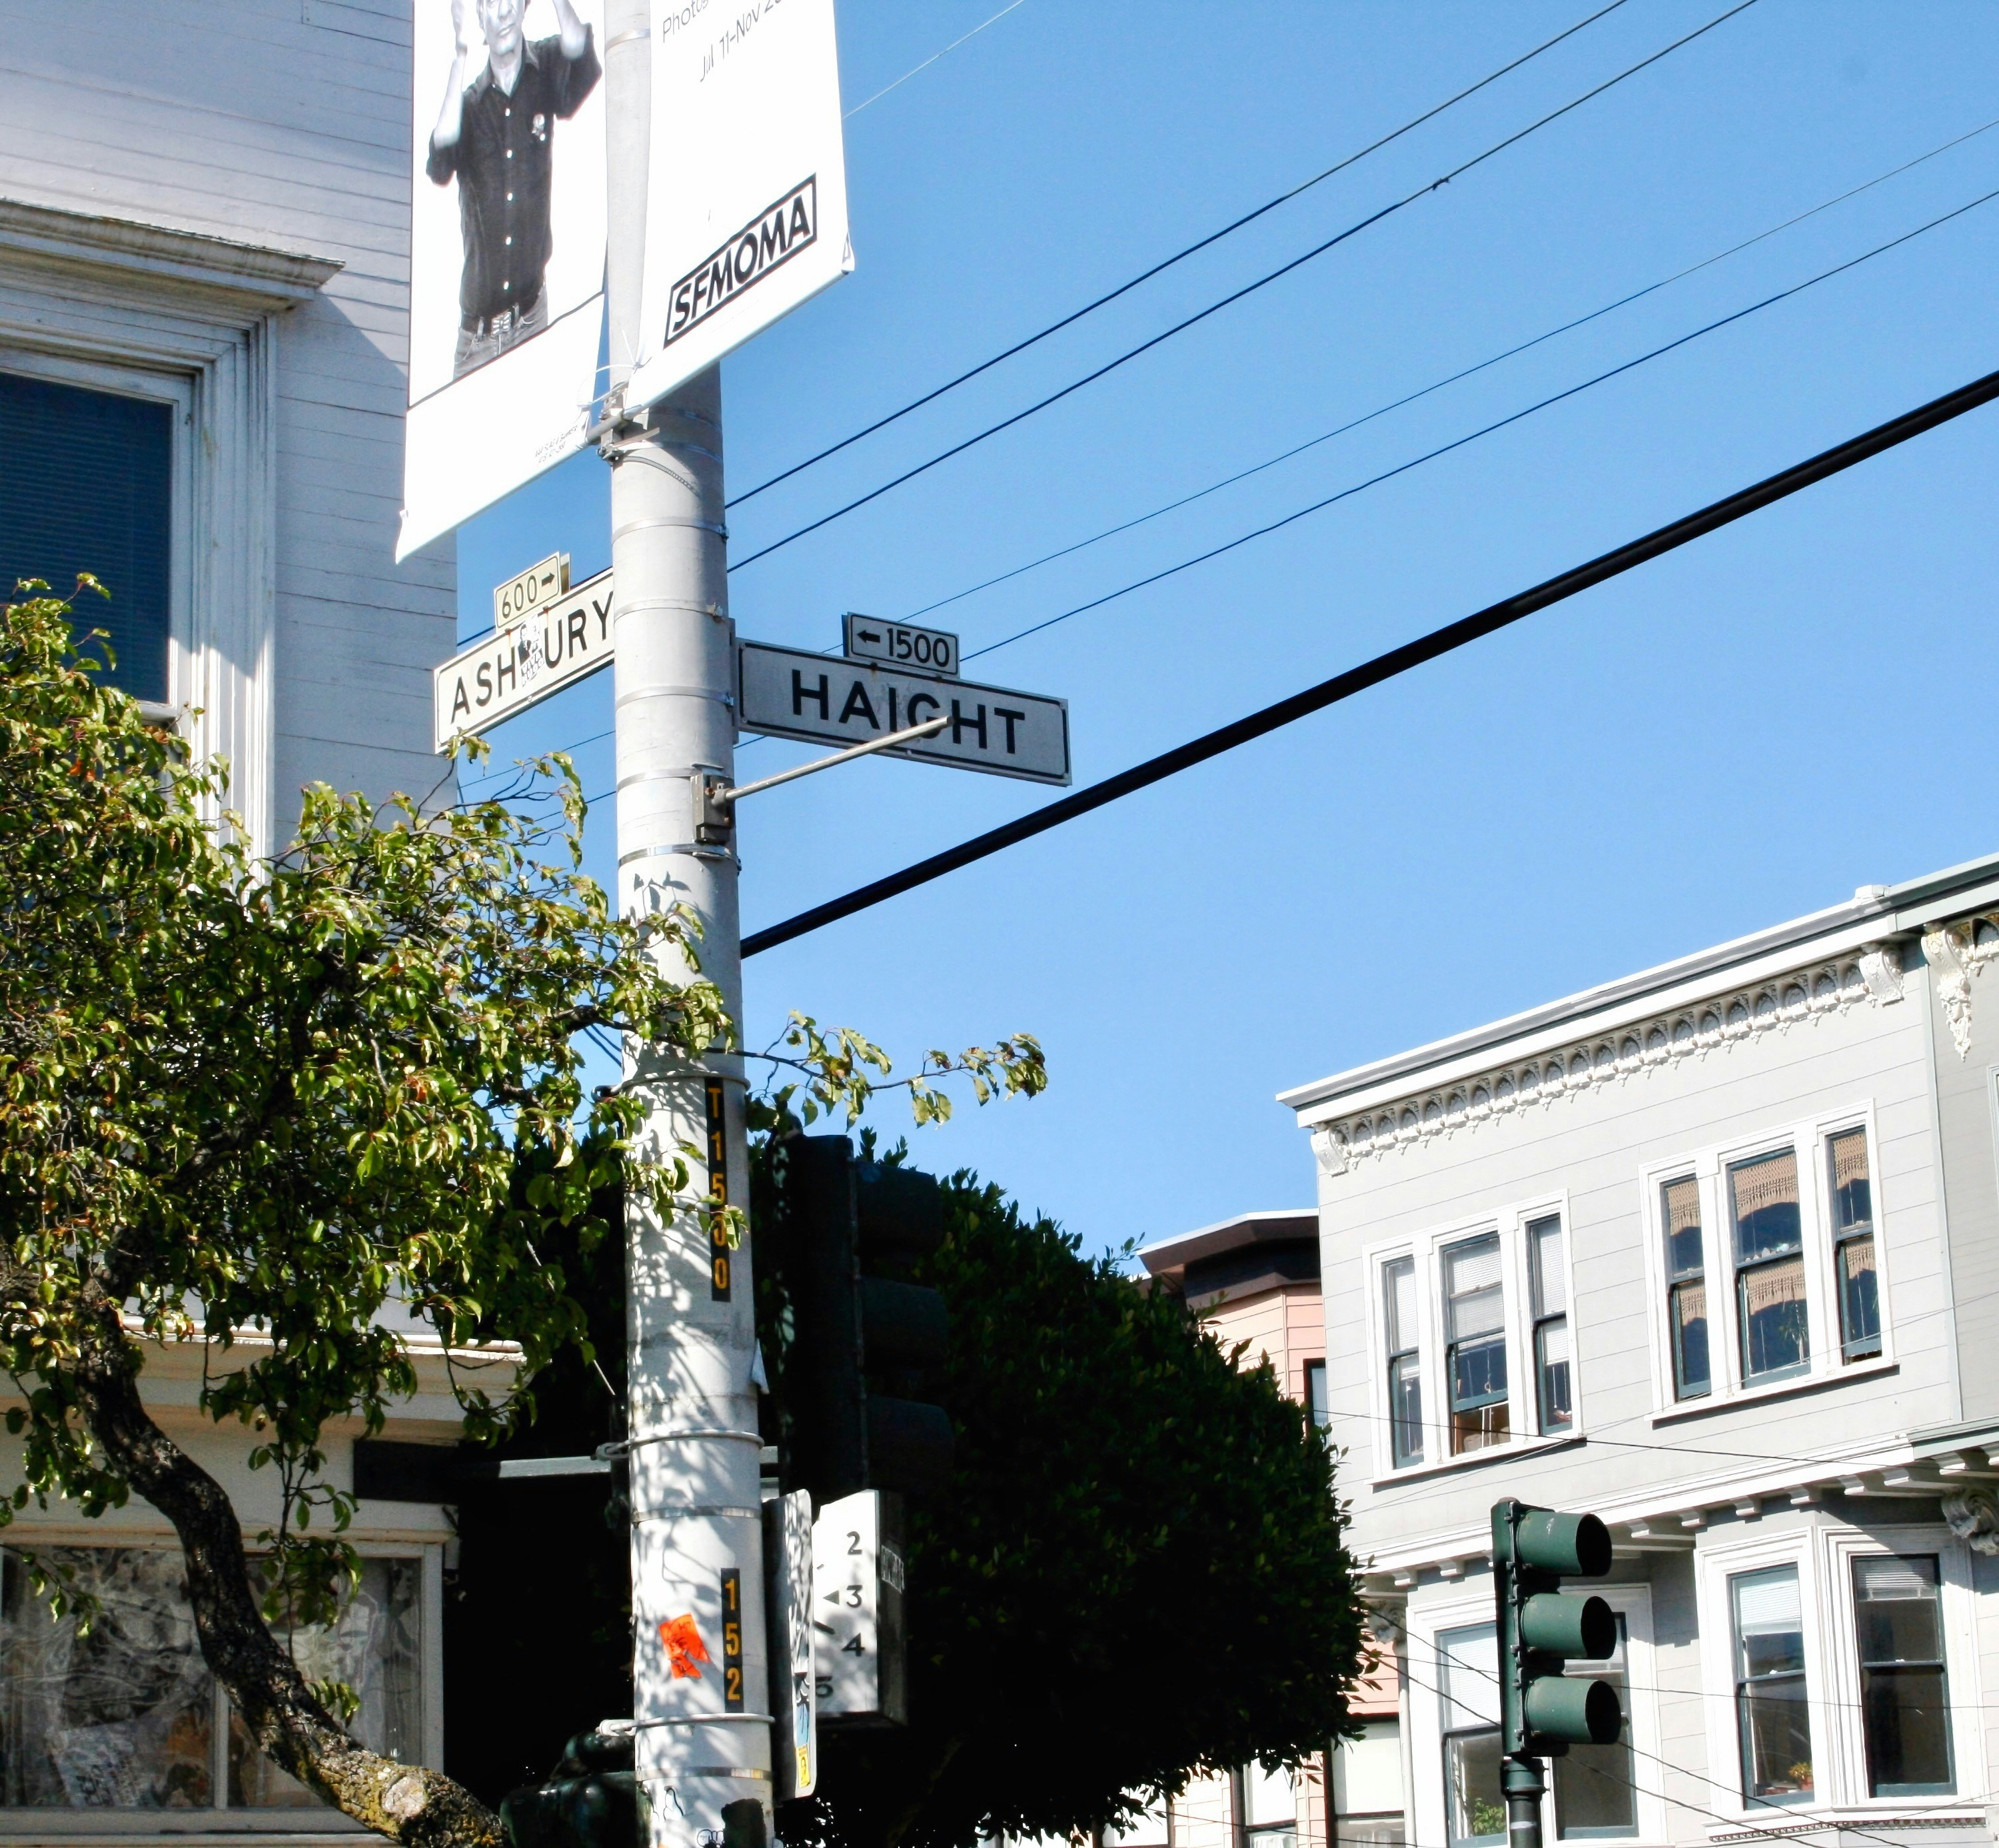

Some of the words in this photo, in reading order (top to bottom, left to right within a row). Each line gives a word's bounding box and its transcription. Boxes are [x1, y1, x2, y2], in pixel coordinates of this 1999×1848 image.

[700, 44, 714, 83] Jul
[672, 194, 810, 333] SFMOMA
[502, 574, 537, 619] 600
[450, 590, 614, 725] ASHURY
[887, 628, 950, 667] 1500
[792, 668, 1025, 754] HAIGHT
[846, 1531, 862, 1555] 2
[846, 1585, 863, 1608] 3
[724, 1578, 741, 1700] 152
[842, 1632, 865, 1657] 4
